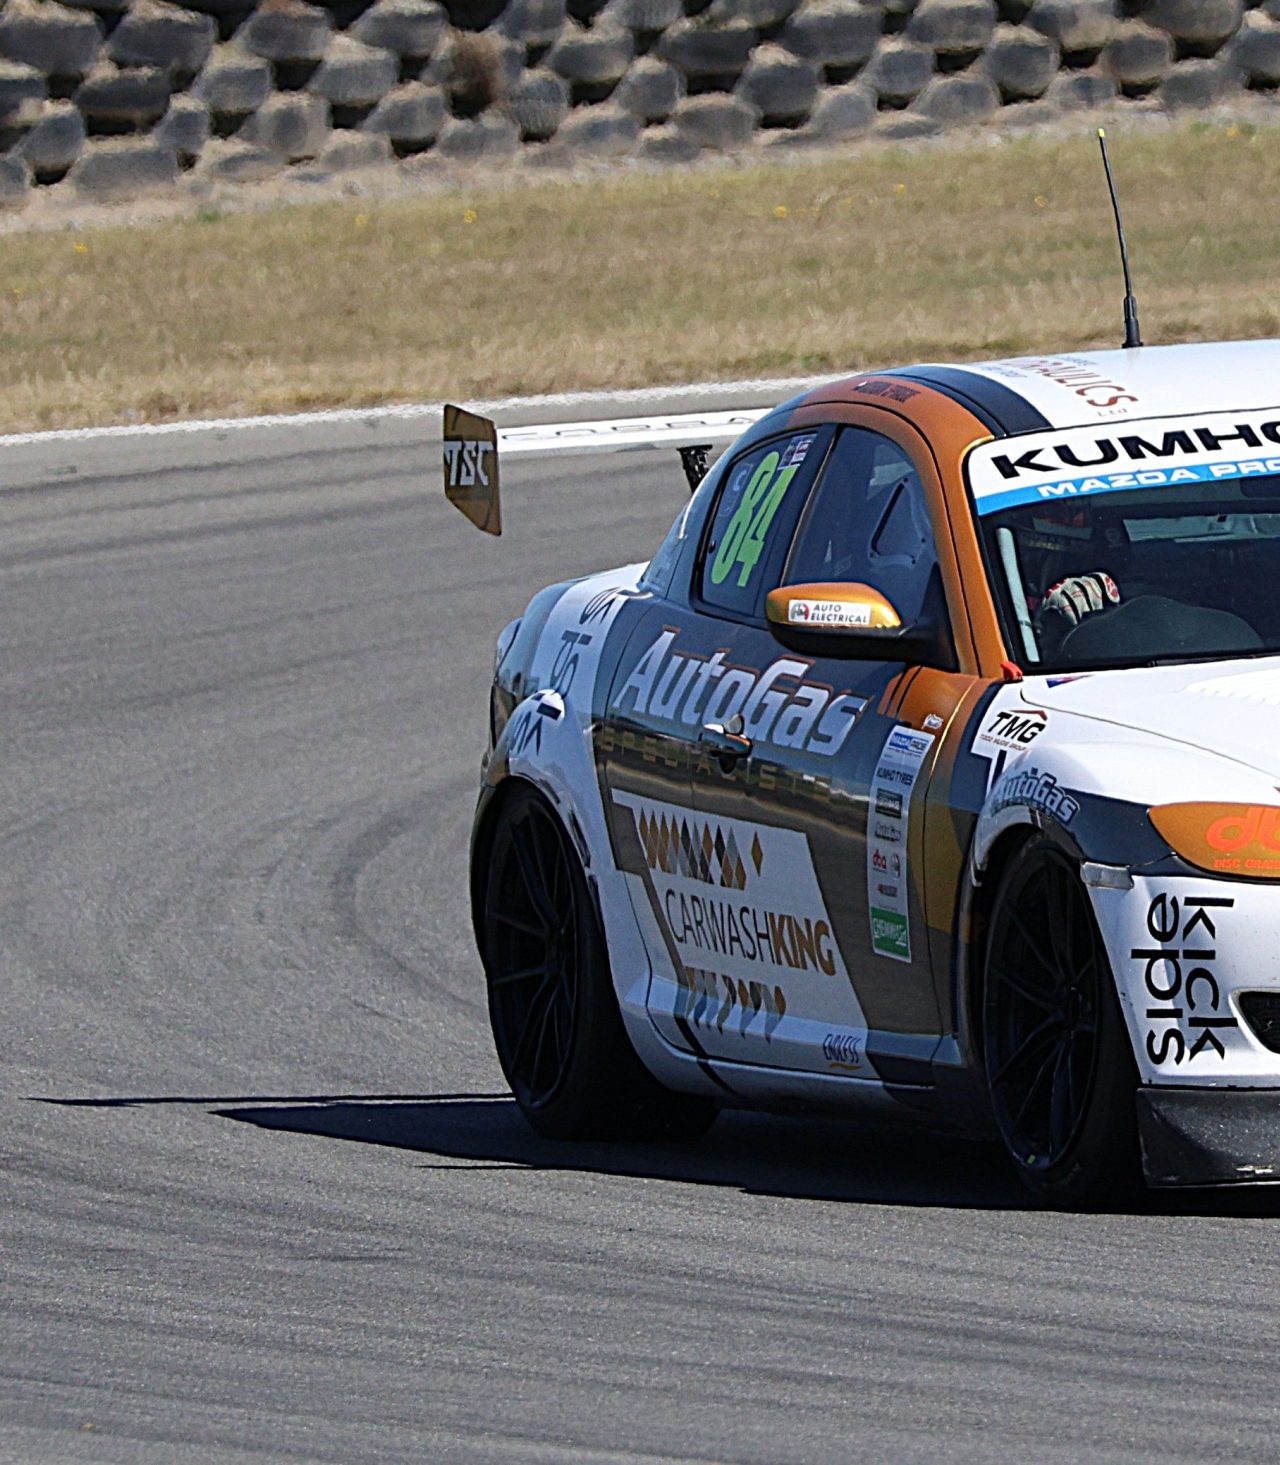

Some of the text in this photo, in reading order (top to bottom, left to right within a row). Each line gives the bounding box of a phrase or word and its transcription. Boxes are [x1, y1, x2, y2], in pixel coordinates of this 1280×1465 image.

[1036, 468, 1201, 498] MAZDA
[709, 450, 798, 590] 84
[811, 612, 867, 623] ELECTRICAL
[813, 604, 842, 613] AUTO
[612, 625, 869, 758] AutoGas
[988, 711, 1047, 744] TMG
[665, 888, 838, 977] CARWASHKING
[822, 1032, 862, 1066] ENDLESS
